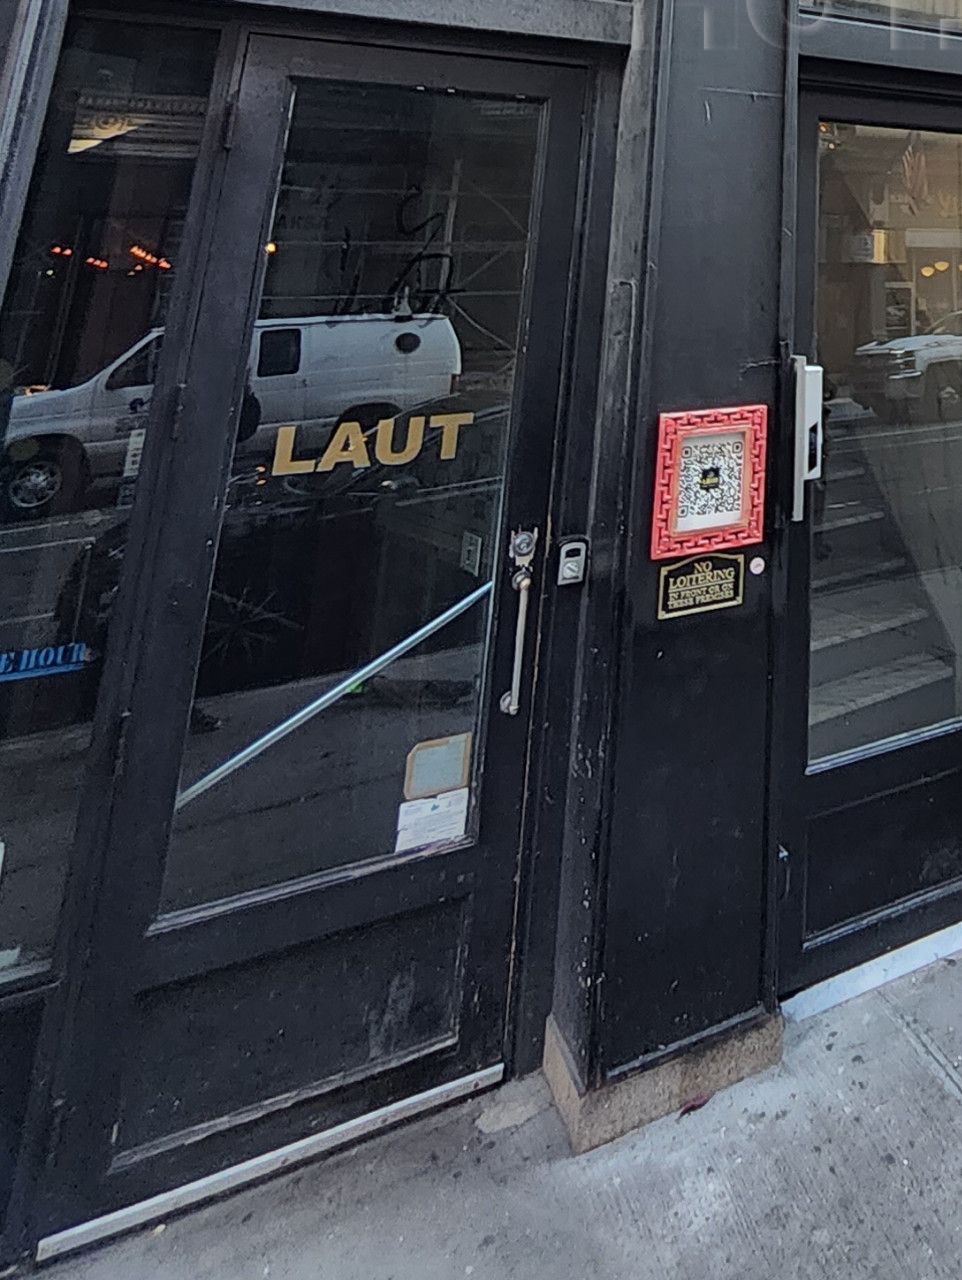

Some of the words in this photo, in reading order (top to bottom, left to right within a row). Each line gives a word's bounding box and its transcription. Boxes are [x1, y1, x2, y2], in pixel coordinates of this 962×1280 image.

[271, 411, 475, 476] LAUT
[694, 561, 712, 574] NO
[668, 568, 736, 589] LOITERING
